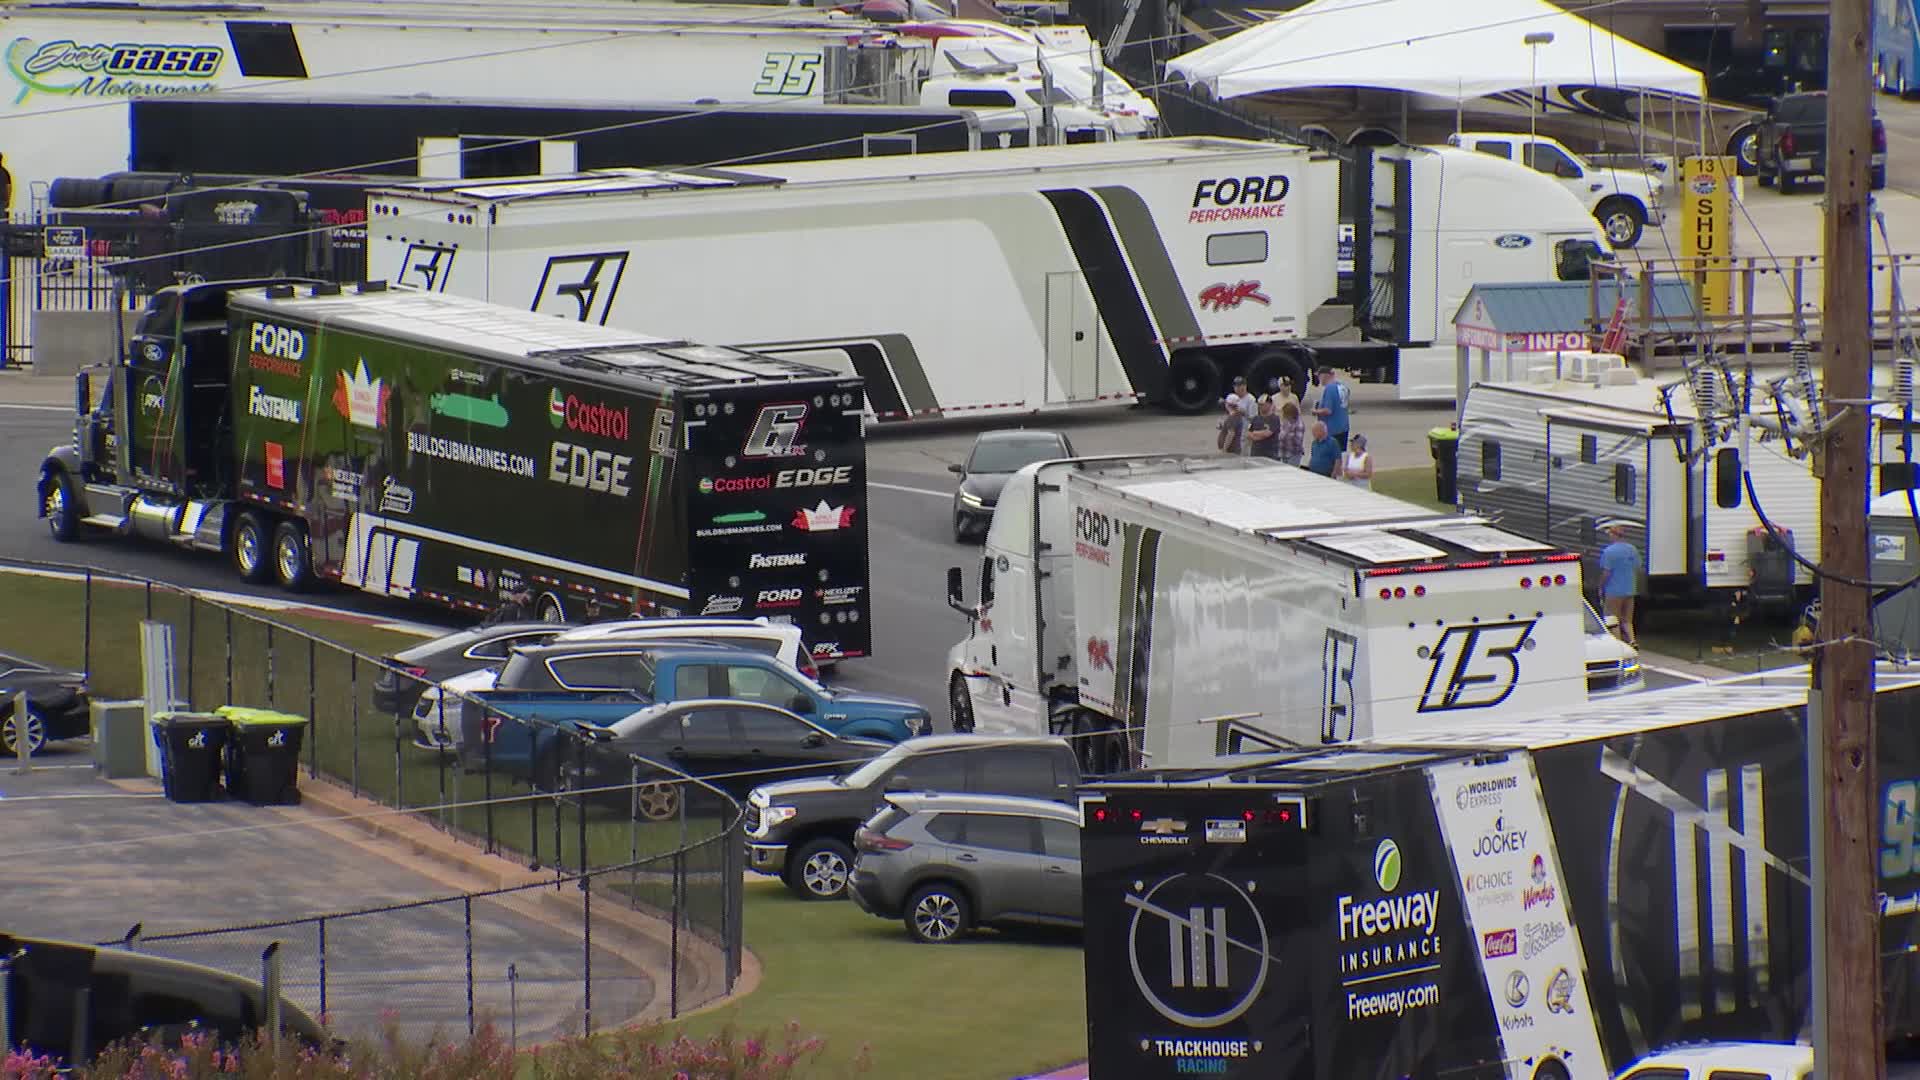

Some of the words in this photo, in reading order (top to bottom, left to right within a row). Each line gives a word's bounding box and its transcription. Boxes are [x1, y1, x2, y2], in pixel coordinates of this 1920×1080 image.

[752, 52, 821, 95] 35
[1696, 159, 1714, 173] 13
[1193, 175, 1290, 207] FORD
[1189, 205, 1286, 223] PERFORMANCE
[251, 322, 304, 360] FORD
[566, 395, 629, 440] Castrol
[649, 407, 675, 453] 6
[743, 403, 809, 457] 6
[407, 431, 536, 479] BUILDSUBMARINES.COM
[549, 441, 632, 496] EDGE
[714, 475, 771, 492] Castrol
[775, 466, 853, 488] EDGE
[696, 524, 783, 537] BUILDSUBMARINES.COM
[1075, 506, 1110, 547] FORD
[757, 588, 802, 602] FORD
[1417, 620, 1537, 713] 15
[1468, 776, 1517, 794] WORLDWIDE
[1470, 793, 1502, 808] EXPRESS
[1140, 836, 1189, 844] CHEVROLET
[1473, 831, 1527, 857] JOCKEY
[1476, 871, 1513, 890] CHOICE
[1339, 890, 1439, 941] Freeway
[1341, 936, 1441, 973] INSURANCE
[1348, 984, 1439, 1020] Freeway.com
[1155, 1040, 1248, 1057] TRACKHOUSE
[1176, 1058, 1227, 1074] RACING
